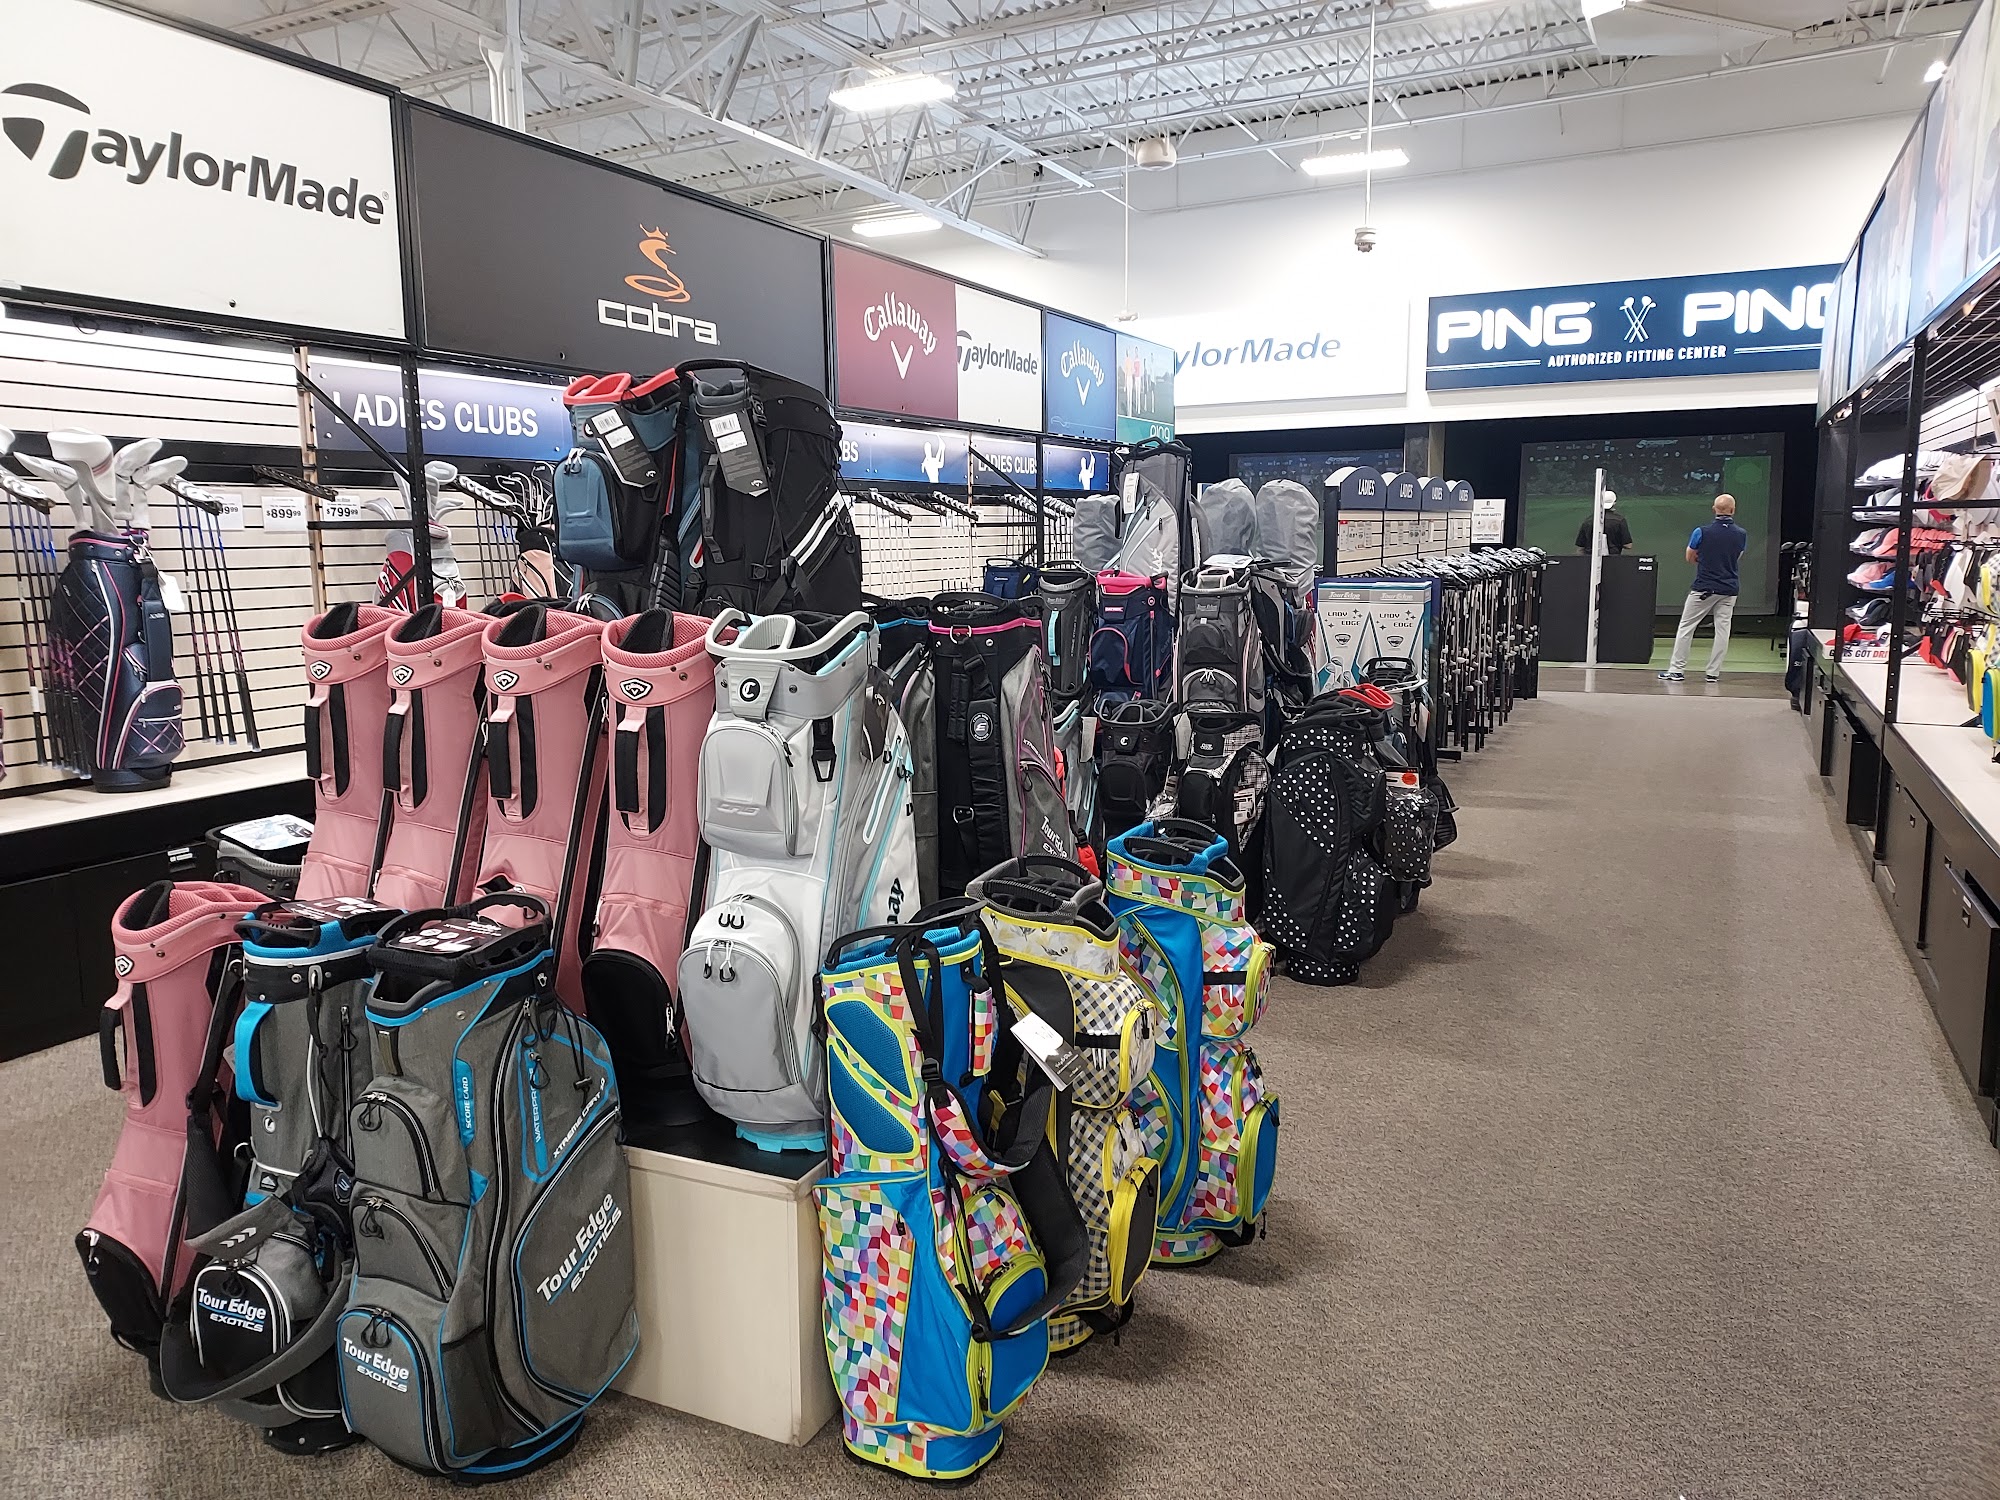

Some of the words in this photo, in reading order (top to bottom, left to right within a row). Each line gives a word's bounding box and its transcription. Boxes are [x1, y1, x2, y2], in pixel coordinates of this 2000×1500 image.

[2, 83, 384, 224] TaylorMade
[598, 299, 718, 345] cobra
[864, 292, 937, 356] Callaway
[1437, 302, 1594, 354] PING
[1060, 339, 1105, 388] Callaway
[1175, 332, 1341, 374] ylorMade
[1547, 350, 1622, 368] AUTHORIZED
[1626, 347, 1674, 364] FITTING
[1678, 344, 1727, 360] CENTER
[454, 401, 539, 438] CLUBS
[1358, 479, 1375, 496] LADIES
[1400, 483, 1414, 499] LADIES
[1431, 487, 1443, 500] LADIES
[1458, 489, 1469, 501] LADIES
[465, 1099, 473, 1129] SCORE
[553, 1116, 584, 1159] XTREME
[537, 1251, 578, 1301] Tour
[575, 1193, 614, 1251] Edge
[570, 1208, 622, 1292] EXOTICS
[198, 1288, 227, 1310] Tour
[228, 1299, 266, 1320] Edge
[210, 1313, 263, 1332] EXOTICS
[343, 1337, 372, 1364] Tour
[373, 1353, 409, 1380] Edge
[356, 1366, 407, 1392] EXOTICS
